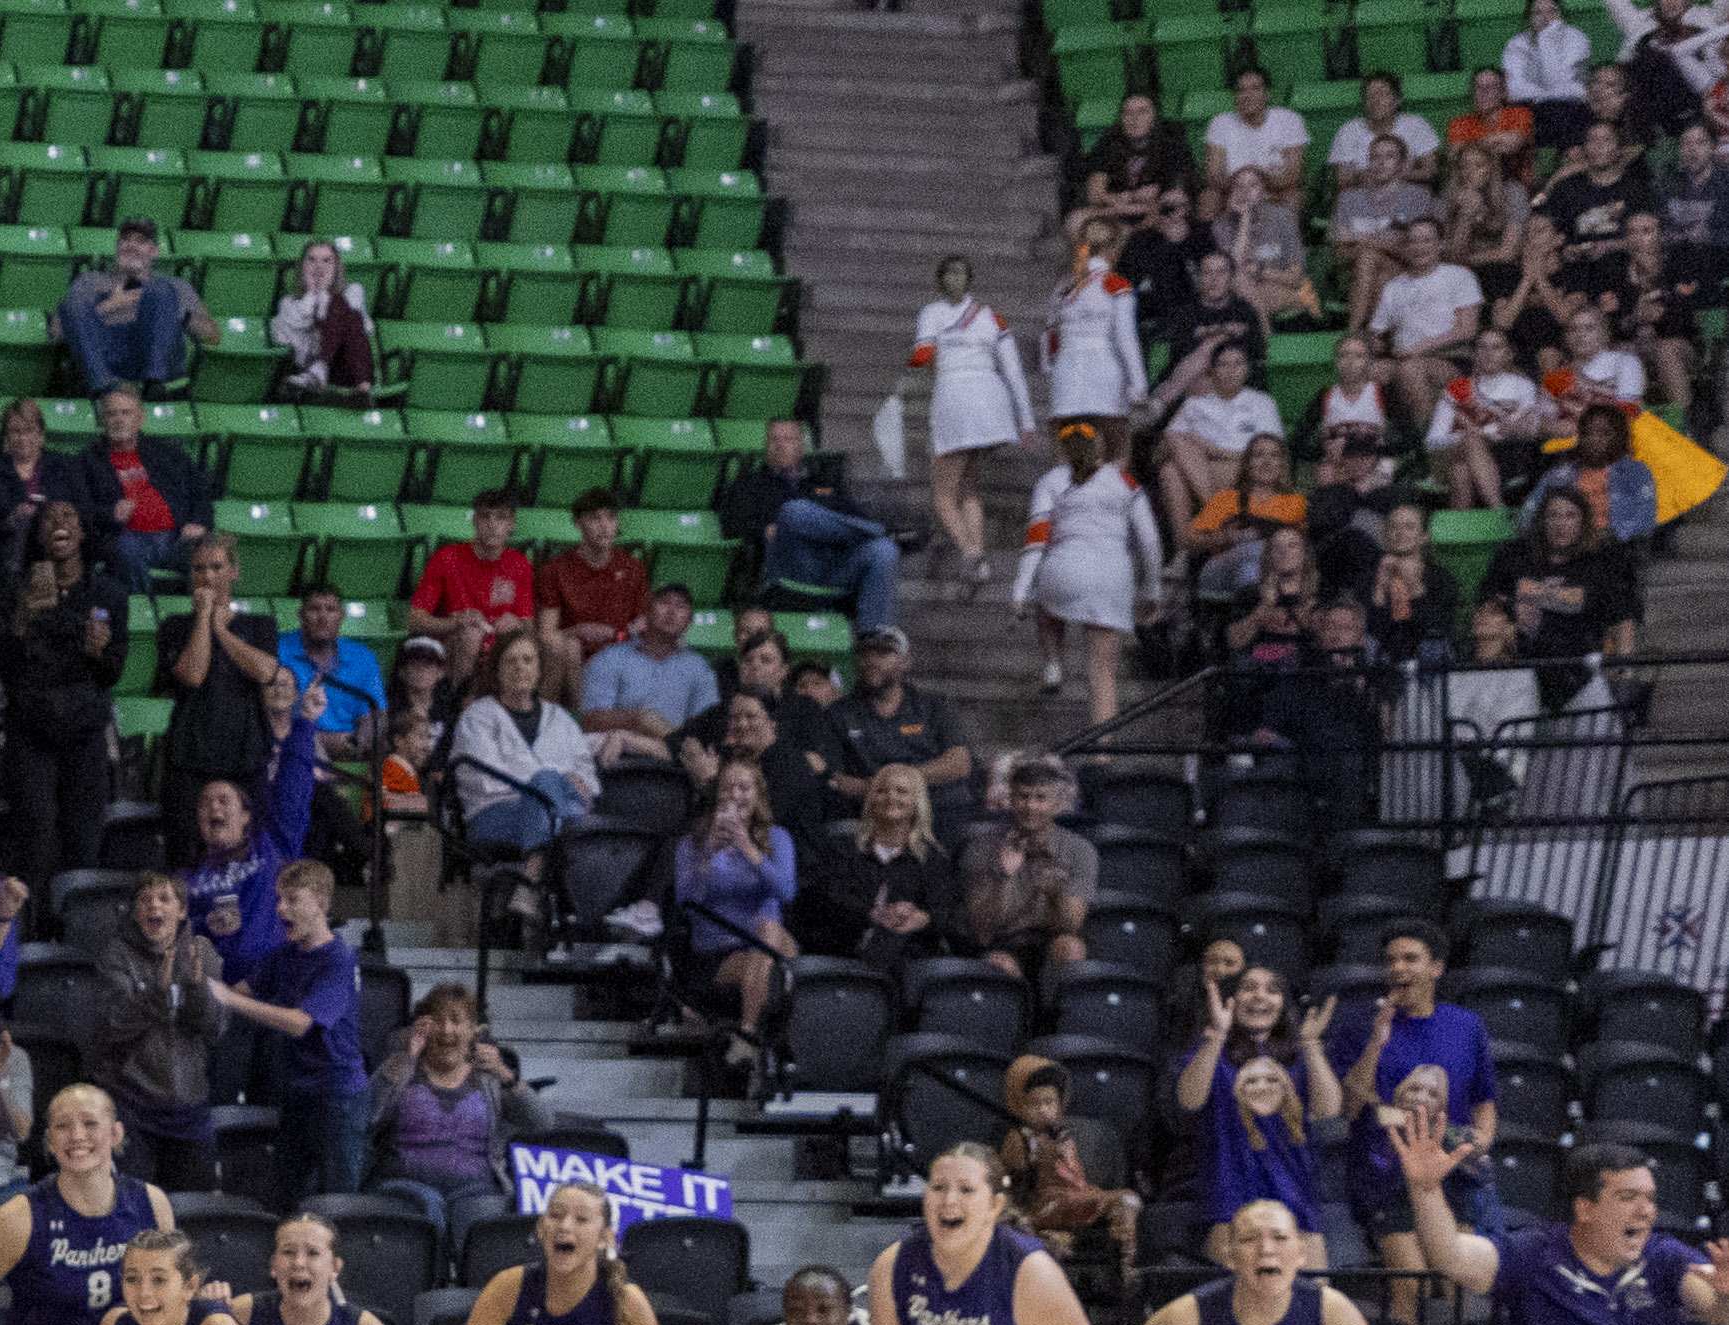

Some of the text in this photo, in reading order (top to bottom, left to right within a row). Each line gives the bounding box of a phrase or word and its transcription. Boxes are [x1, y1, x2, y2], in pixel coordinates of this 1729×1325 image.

[513, 1147, 732, 1213] MAKE IT
[87, 1270, 113, 1309] 8
